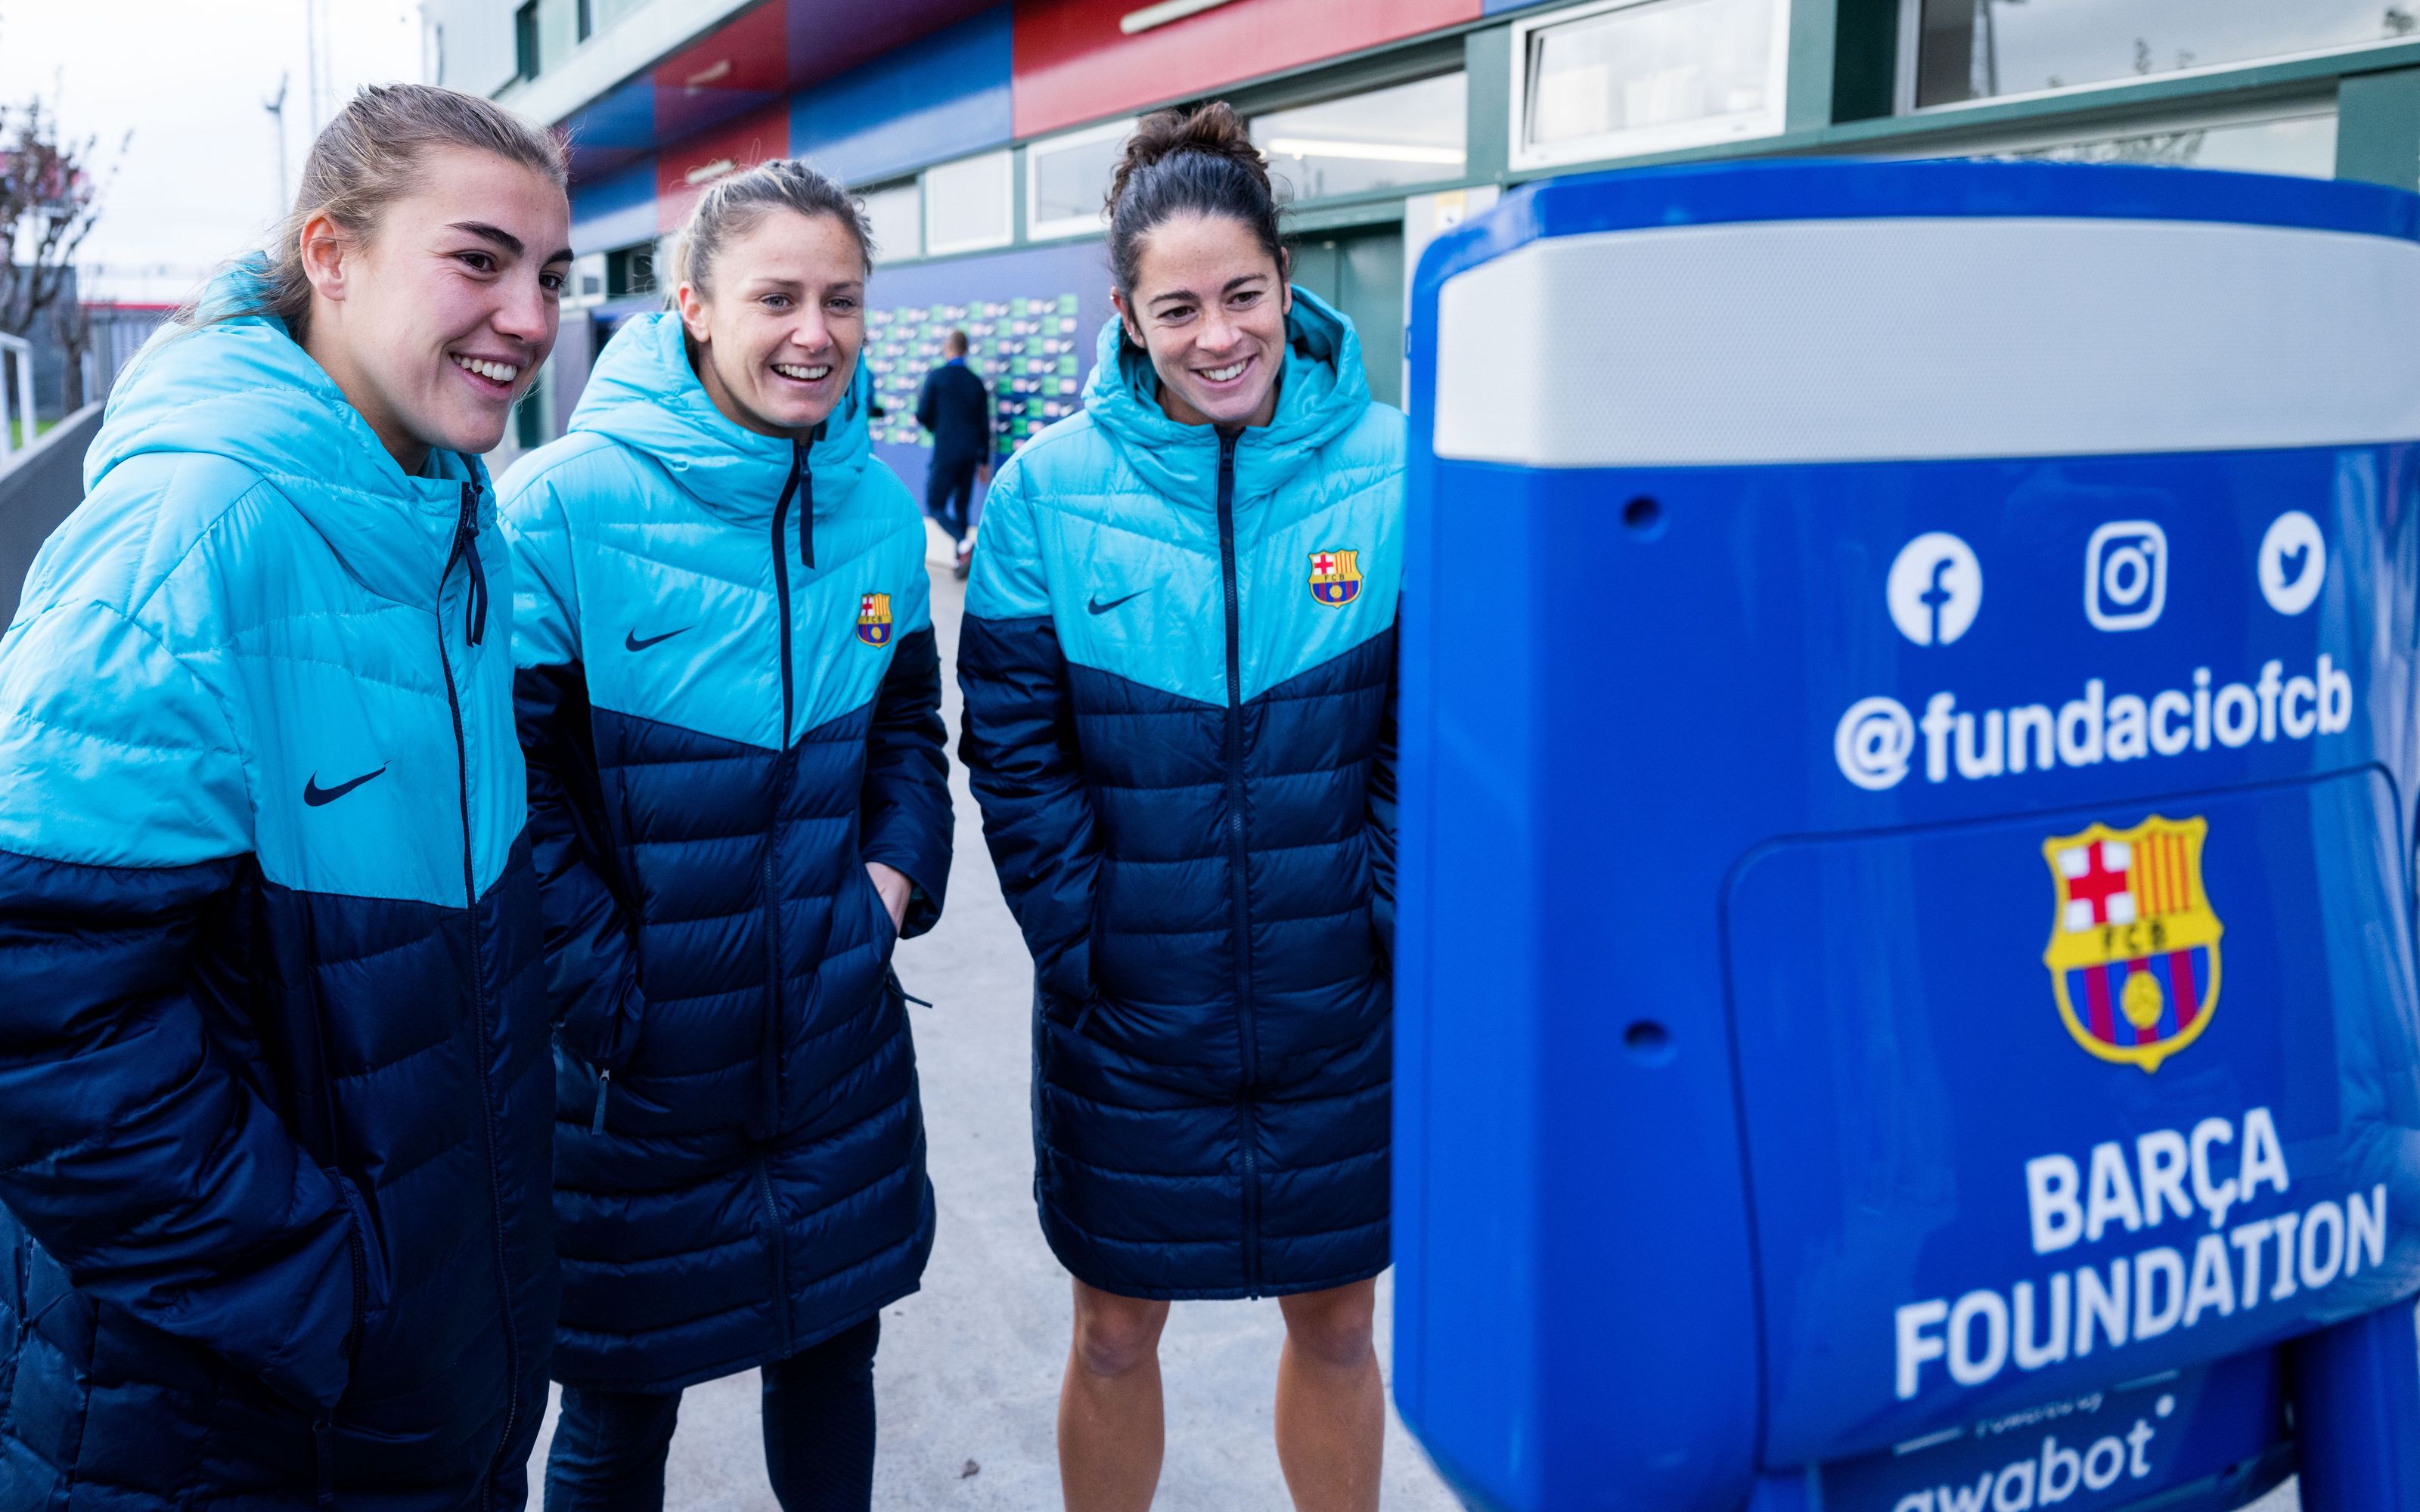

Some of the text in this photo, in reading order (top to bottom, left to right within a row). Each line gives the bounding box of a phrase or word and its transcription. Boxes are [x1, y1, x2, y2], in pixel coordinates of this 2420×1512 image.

[1835, 654, 2353, 790] @fundaciofcb
[2102, 920, 2167, 956] FCB
[2027, 1107, 2288, 1254] BARÇA
[1894, 1184, 2389, 1399] FOUNDATION
